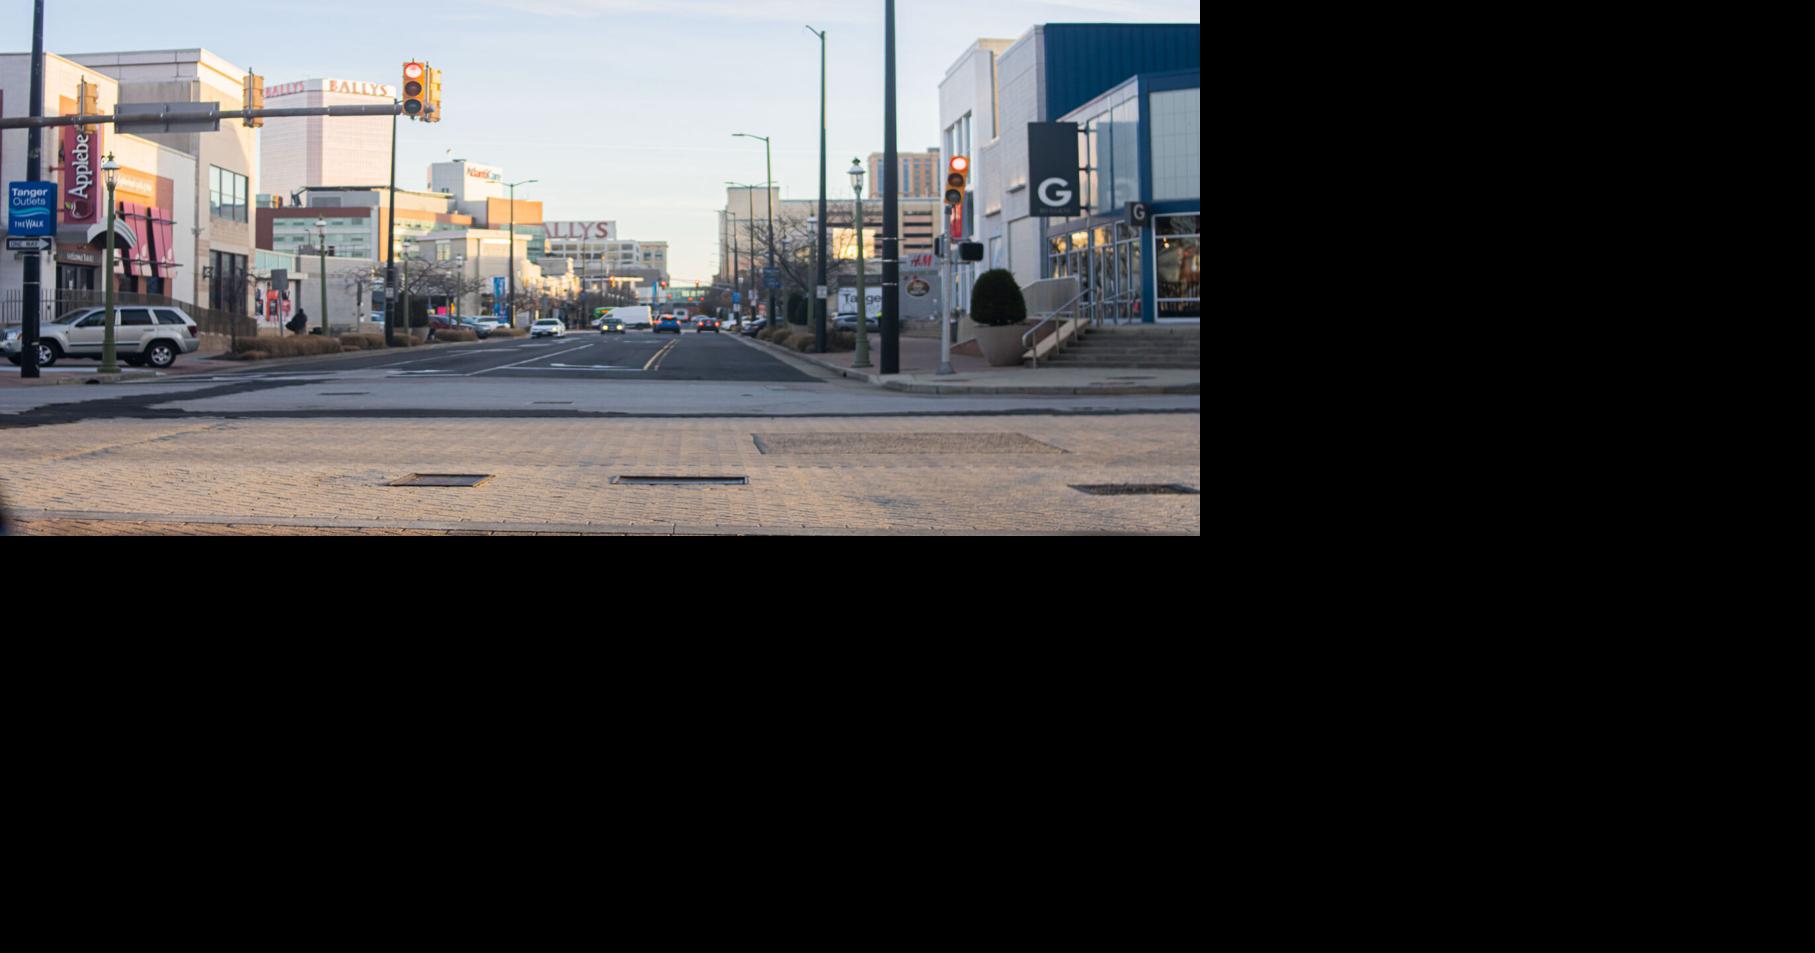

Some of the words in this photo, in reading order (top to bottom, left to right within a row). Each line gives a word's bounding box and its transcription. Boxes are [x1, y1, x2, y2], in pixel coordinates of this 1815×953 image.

[329, 80, 388, 96] BALLYS
[68, 124, 93, 199] Applebe
[12, 187, 48, 198] Tanger
[1037, 176, 1073, 208] G
[13, 197, 46, 206] Outlets
[1132, 203, 1146, 221] G
[842, 293, 882, 305] Tage
